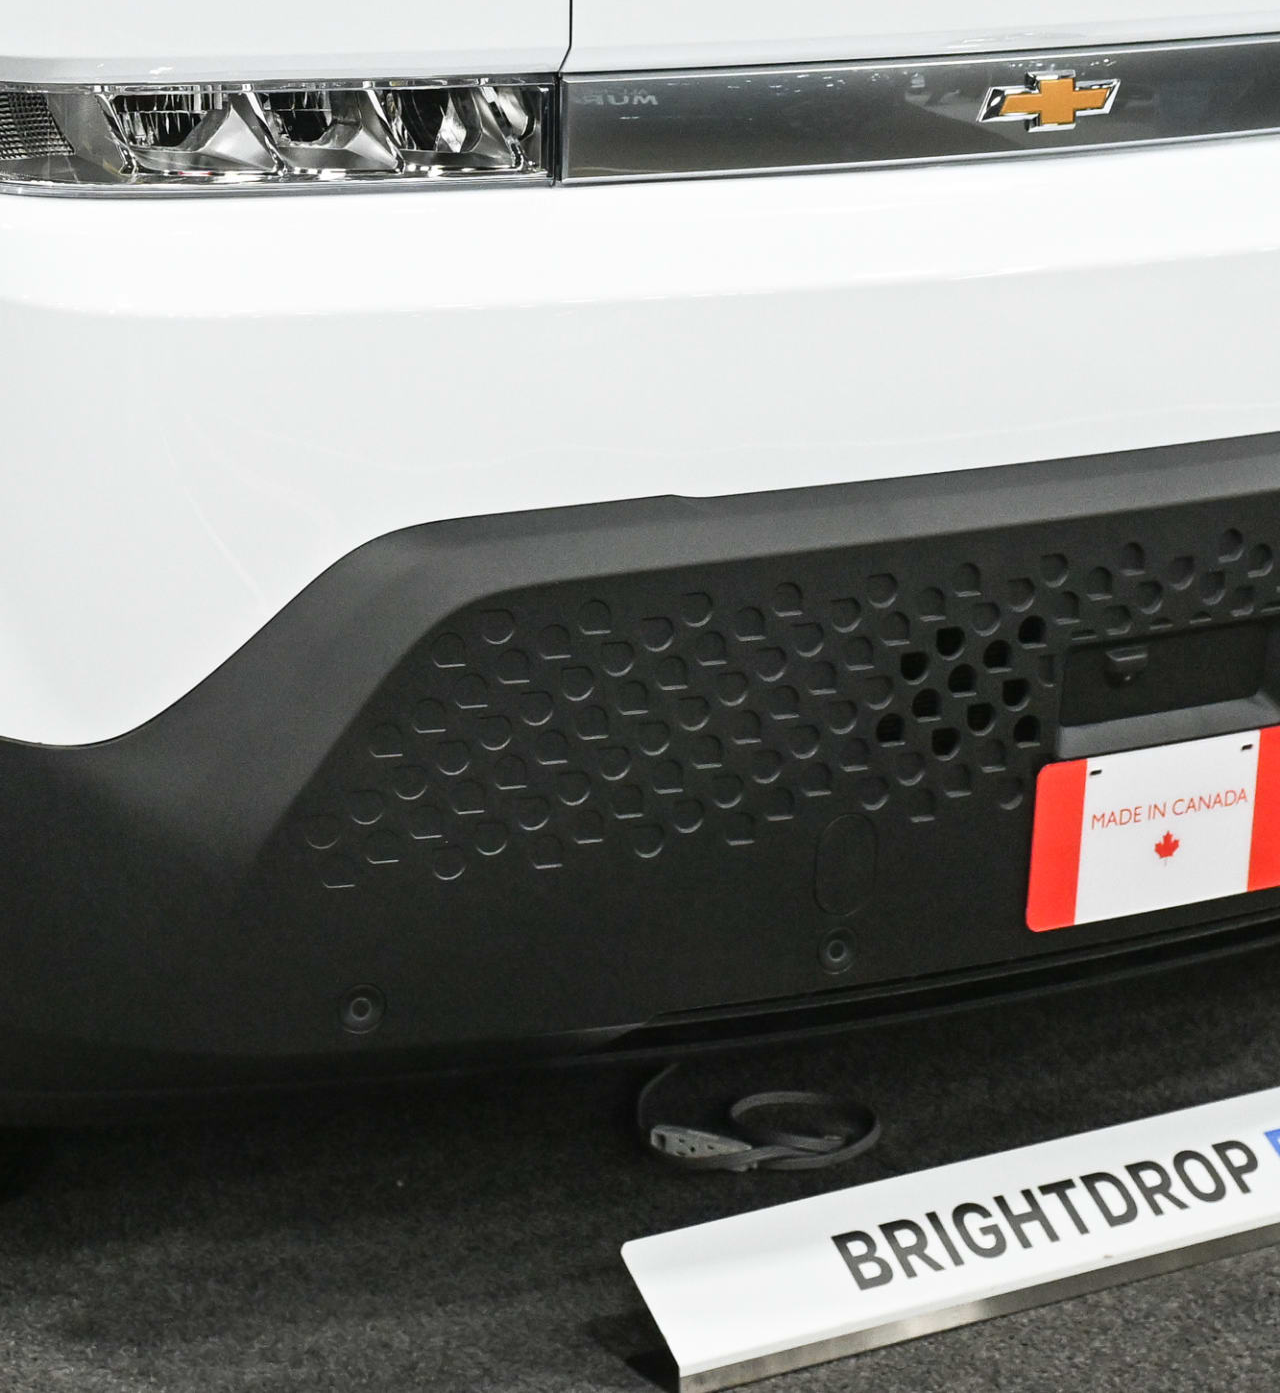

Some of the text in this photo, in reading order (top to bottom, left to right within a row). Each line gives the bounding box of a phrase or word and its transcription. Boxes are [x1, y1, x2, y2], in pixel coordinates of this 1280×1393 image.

[1090, 787, 1249, 831] MADE IN CANADA
[831, 1139, 1260, 1293] BRIGHTDROP
